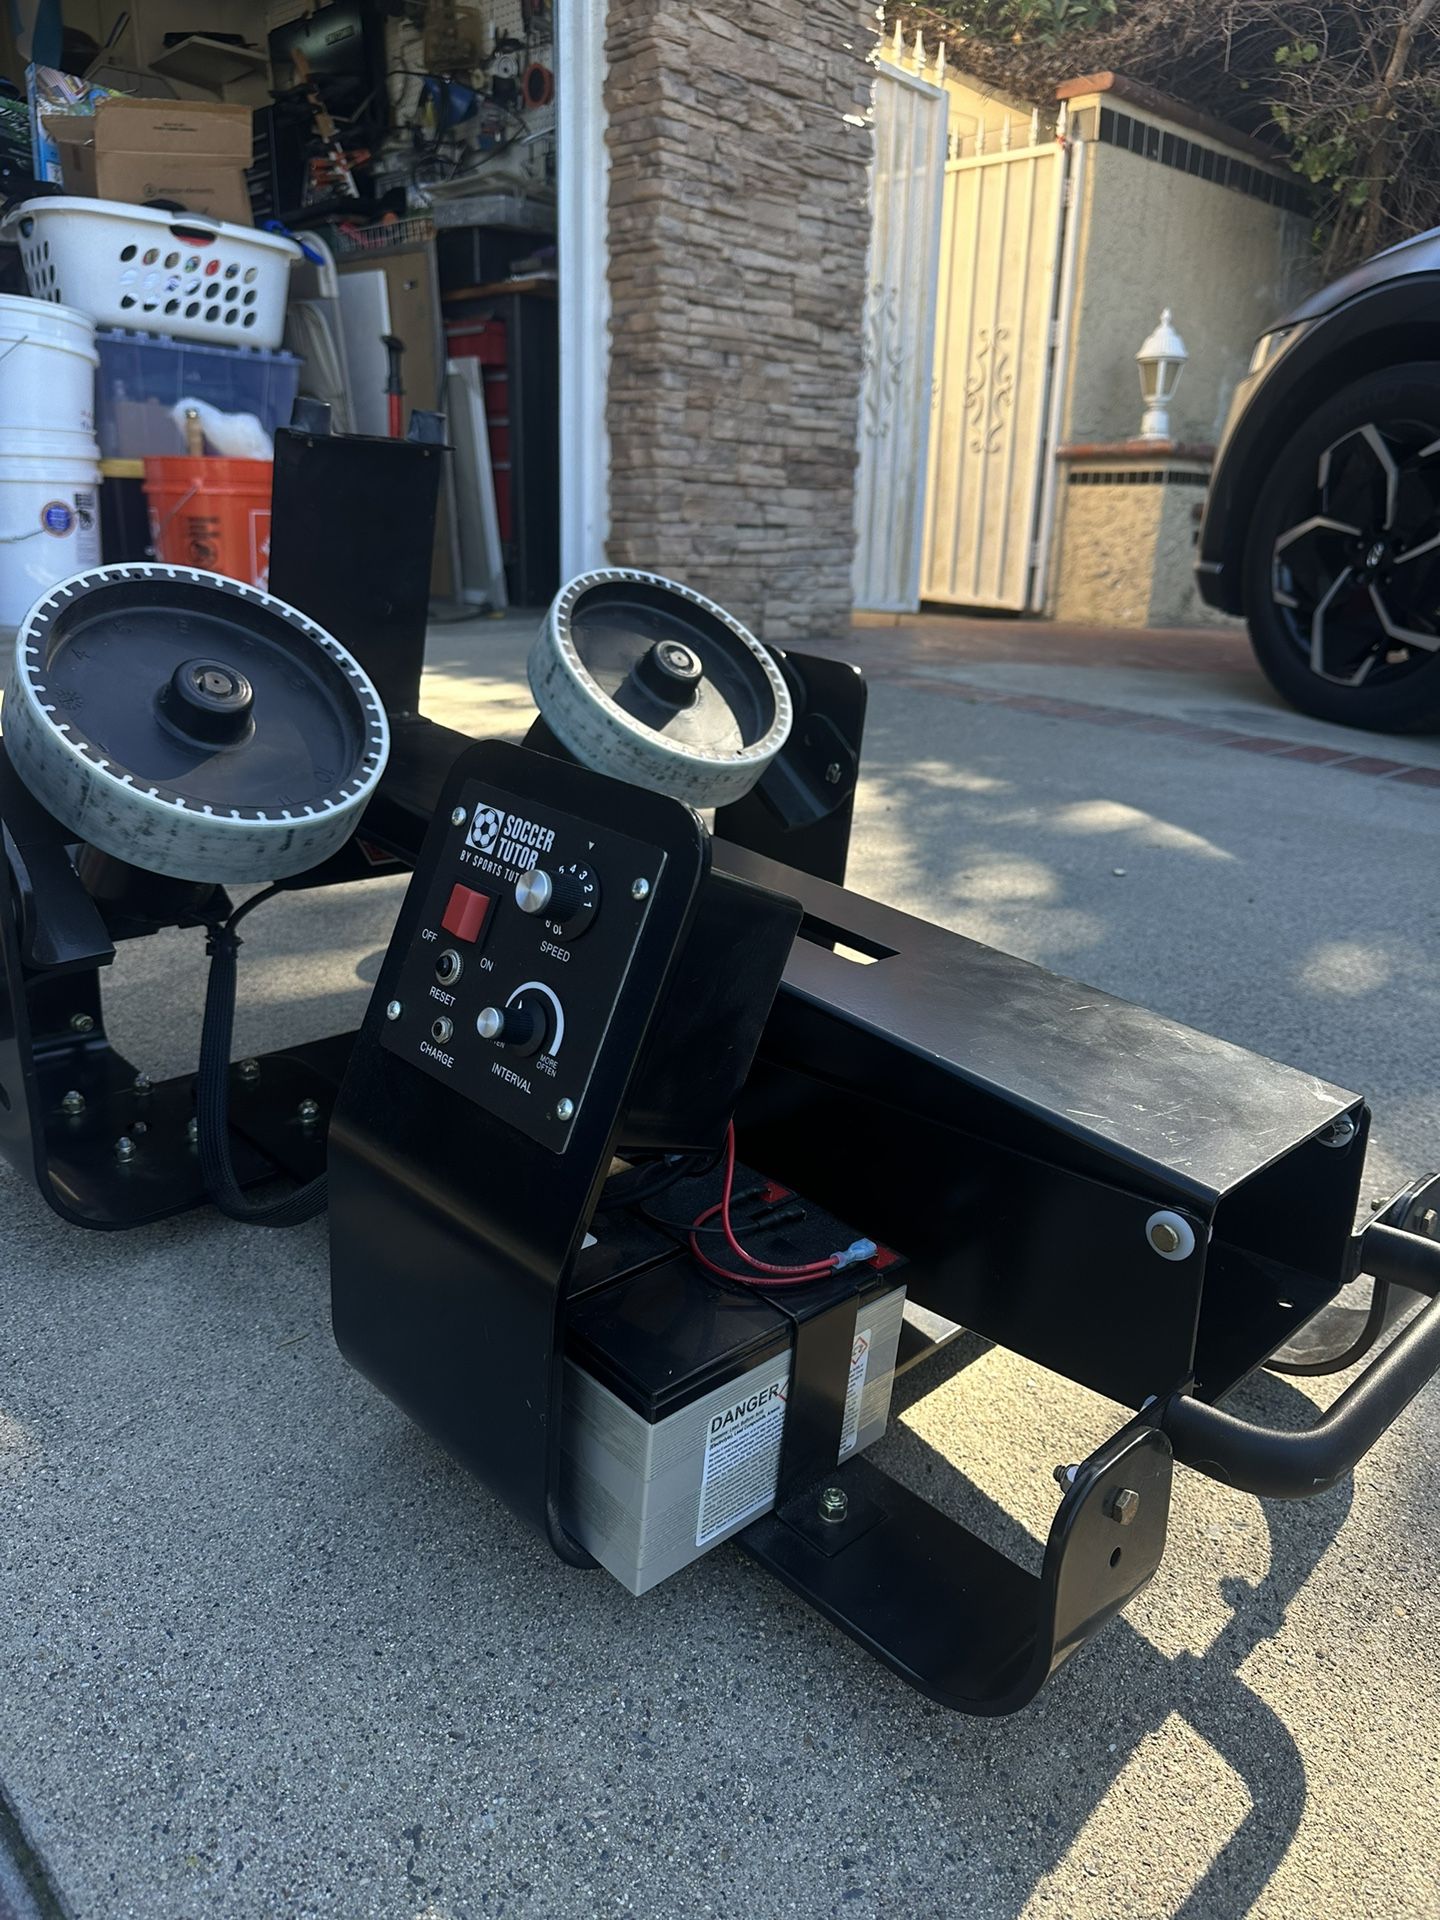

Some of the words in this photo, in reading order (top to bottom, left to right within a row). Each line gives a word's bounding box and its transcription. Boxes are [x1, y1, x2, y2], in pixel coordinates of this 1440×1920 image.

[503, 814, 556, 853] SOCCER
[496, 837, 539, 871] TUTOR
[459, 849, 472, 862] BY
[472, 855, 503, 877] SPORTS
[505, 868, 521, 884] TUT
[569, 863, 577, 874] 4
[578, 870, 588, 881] 3
[583, 884, 594, 894] 2
[421, 928, 439, 943] OFF
[552, 924, 564, 936] 10
[539, 940, 571, 963] SPEED
[479, 957, 495, 972] ON
[429, 985, 457, 1007] RESET
[419, 1040, 455, 1069] CHARGE
[539, 1053, 559, 1070] MORE
[491, 1062, 532, 1095] INTERVAL
[535, 1061, 557, 1078] OFTEN
[711, 1383, 779, 1434] DANGER
